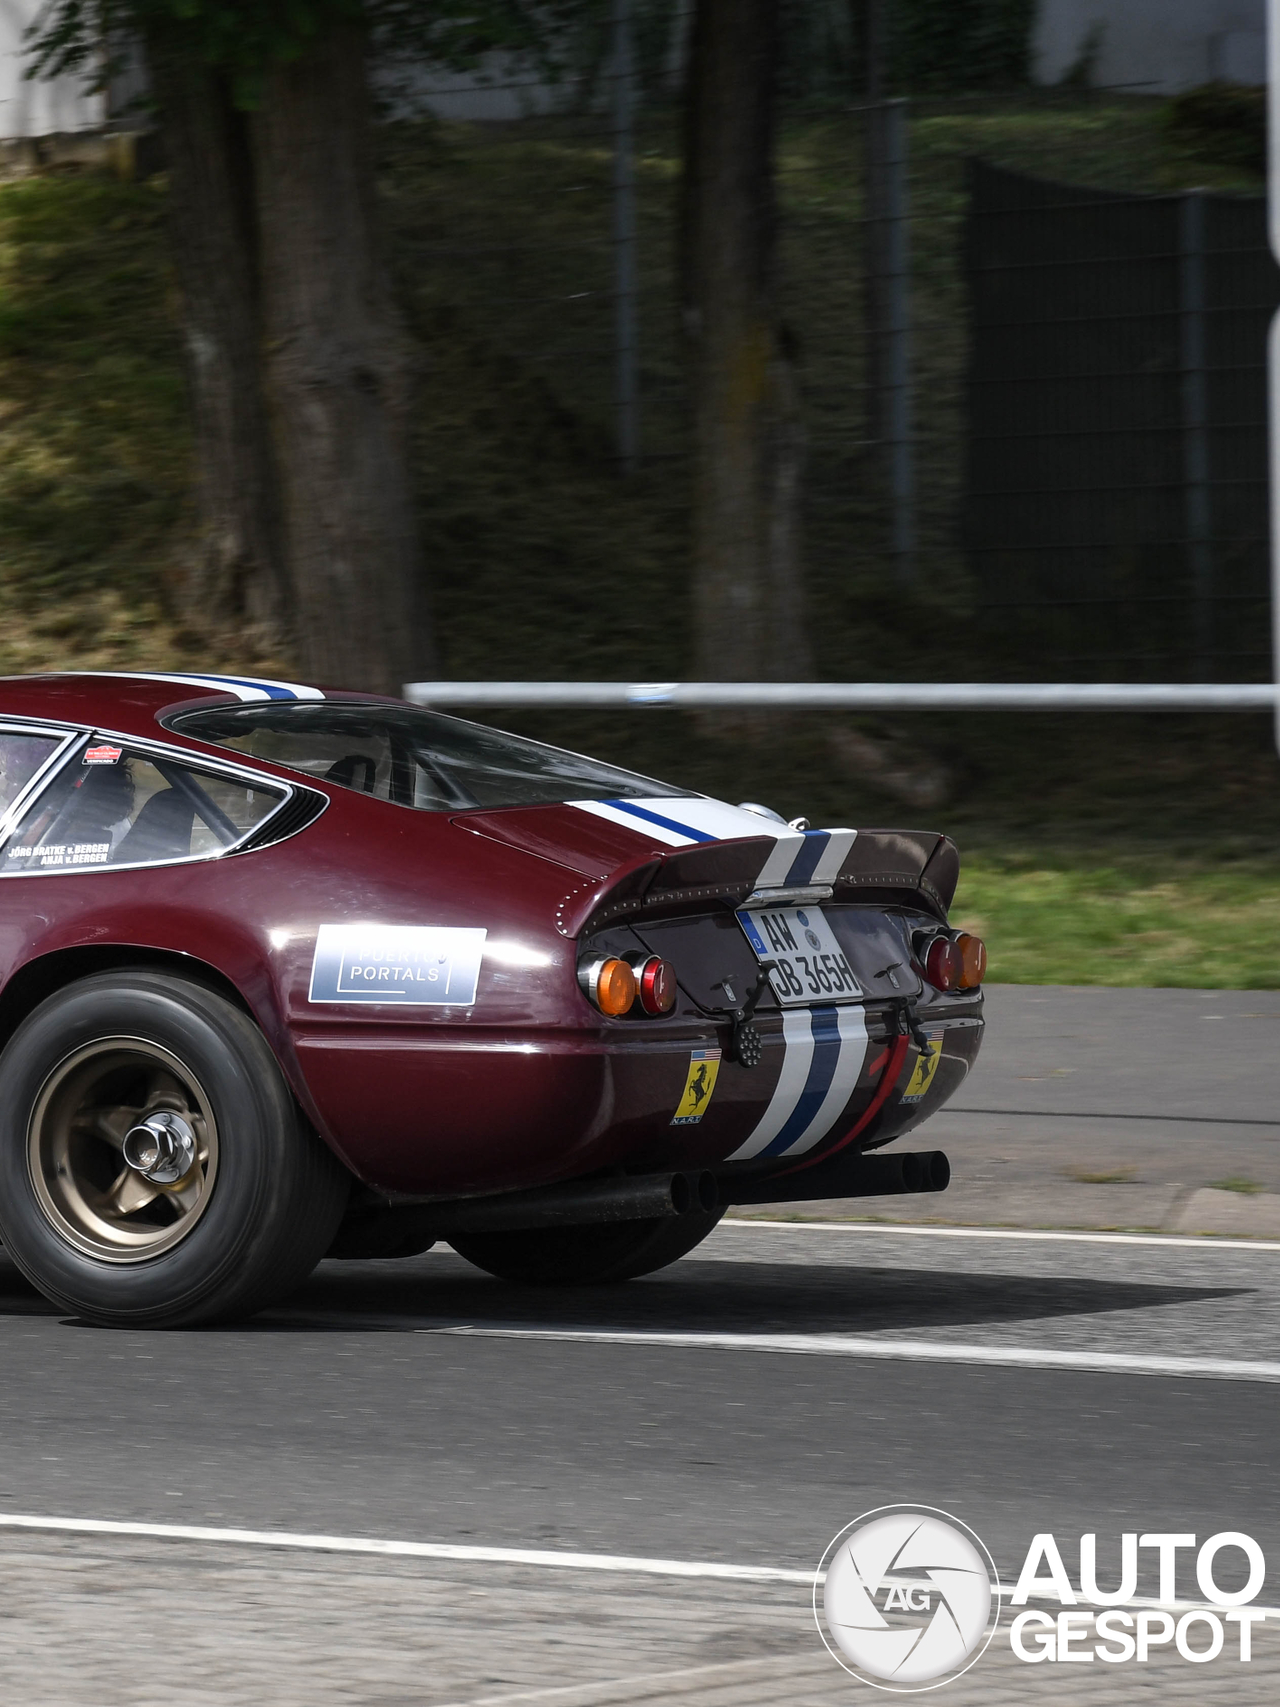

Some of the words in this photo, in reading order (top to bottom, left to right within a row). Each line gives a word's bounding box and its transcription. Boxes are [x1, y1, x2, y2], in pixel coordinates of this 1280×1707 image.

[32, 845, 67, 856] BRATKE
[760, 913, 799, 953] AW
[349, 965, 440, 982] PORTALS
[794, 953, 861, 995] 365H
